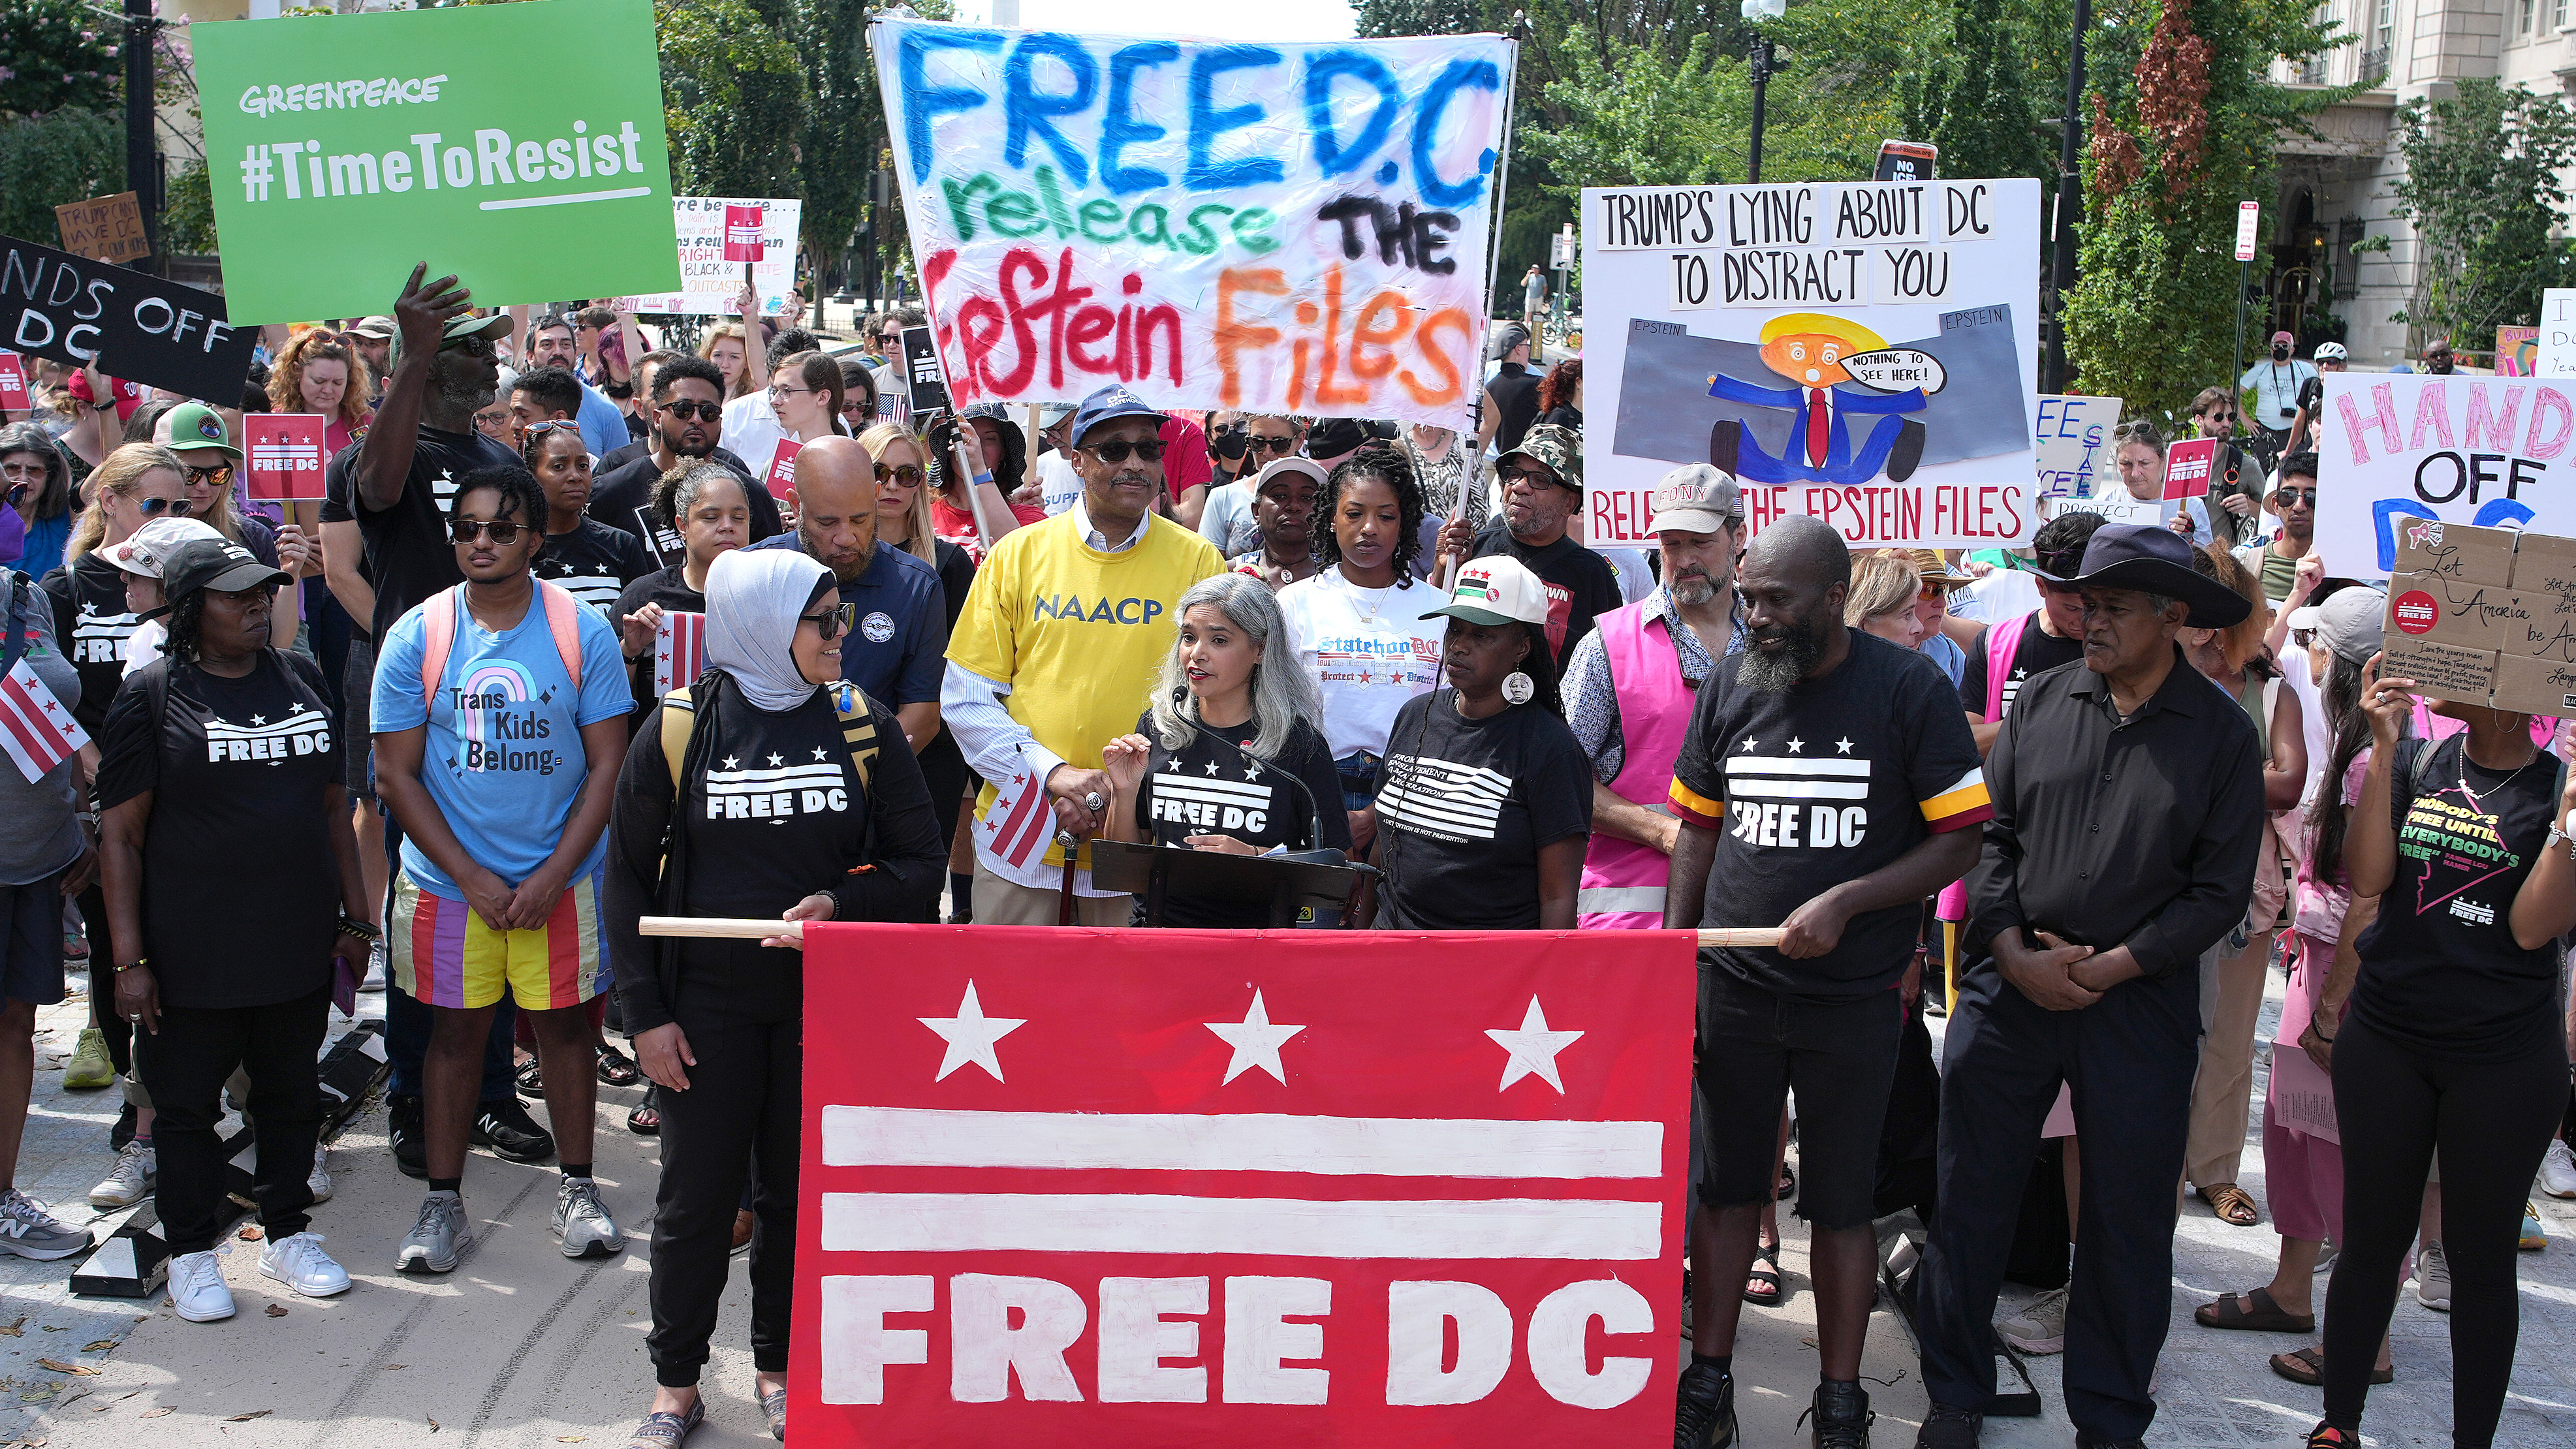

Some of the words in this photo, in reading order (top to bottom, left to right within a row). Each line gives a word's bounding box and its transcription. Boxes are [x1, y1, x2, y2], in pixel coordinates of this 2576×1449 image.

[239, 74, 448, 118] GREENPEACE
[900, 30, 1285, 196] FREE
[240, 119, 644, 202] #TimeToResist
[1896, 159, 1915, 174] NO
[61, 206, 110, 227] TRUMP
[940, 164, 1283, 255] release
[1317, 193, 1462, 277] THE
[1729, 189, 1812, 247] LYING
[1836, 185, 1924, 239] ABOUT
[1947, 184, 1990, 236] DC
[727, 234, 756, 244] FREE
[685, 263, 720, 276] BLACK
[1671, 254, 1708, 304] TO
[1724, 249, 1864, 304] DISTRACT
[1885, 248, 1949, 298] YOU
[1634, 320, 1681, 336] EPSTEIN
[1945, 307, 2003, 331] EPSTEIN
[2552, 298, 2572, 322] I
[14, 307, 101, 360] DC
[134, 297, 236, 354] OFF
[1852, 352, 1901, 366] NOTHING
[1908, 352, 1924, 364] TO
[915, 370, 941, 384] FR
[1860, 369, 1883, 381] SEE
[1891, 367, 1928, 381] HERE!
[3, 382, 22, 392] DC
[2334, 380, 2576, 467] HAND
[253, 458, 293, 471] FREE
[296, 458, 319, 471] DC
[774, 469, 795, 483] FR
[2169, 470, 2193, 482] FREE
[2193, 469, 2207, 479] DC
[2413, 451, 2547, 505] OFF
[1657, 484, 1709, 507] FDNY
[1593, 490, 1659, 541] RELE
[1806, 486, 1921, 541] EPSTEIN
[1934, 486, 2022, 539] FILES
[660, 538, 685, 553] FR
[2421, 543, 2464, 584] Let
[1033, 593, 1164, 625] NAACP
[2527, 623, 2545, 642] be
[2388, 650, 2399, 659] full
[2406, 654, 2432, 665] strength
[2453, 660, 2476, 673] Tangled
[2445, 650, 2464, 661] young
[1321, 670, 1355, 683] Protect
[1406, 671, 1435, 685] District
[449, 687, 505, 710] Trans
[495, 710, 550, 740] Kids
[208, 737, 289, 763] FREE
[294, 731, 331, 757] DC
[467, 740, 554, 776] Belong
[706, 792, 795, 820] FREE
[800, 788, 849, 814] DC
[1151, 797, 1219, 827] FREE
[1221, 805, 1268, 834] DC
[1419, 828, 1433, 837] NOT
[1432, 832, 1469, 845] PREVENTION
[1731, 800, 1800, 849] FREE
[1809, 805, 1868, 849] DC
[2407, 811, 2446, 828] FREE
[2445, 818, 2499, 843] UNTIL
[2443, 859, 2472, 873] HAMER
[2445, 852, 2472, 865] FANNIE
[2472, 860, 2490, 870] LOU
[2449, 907, 2476, 921] FREE
[2476, 916, 2494, 926] DC
[821, 1271, 1331, 1406] FREE
[1385, 1276, 1656, 1410] DC
